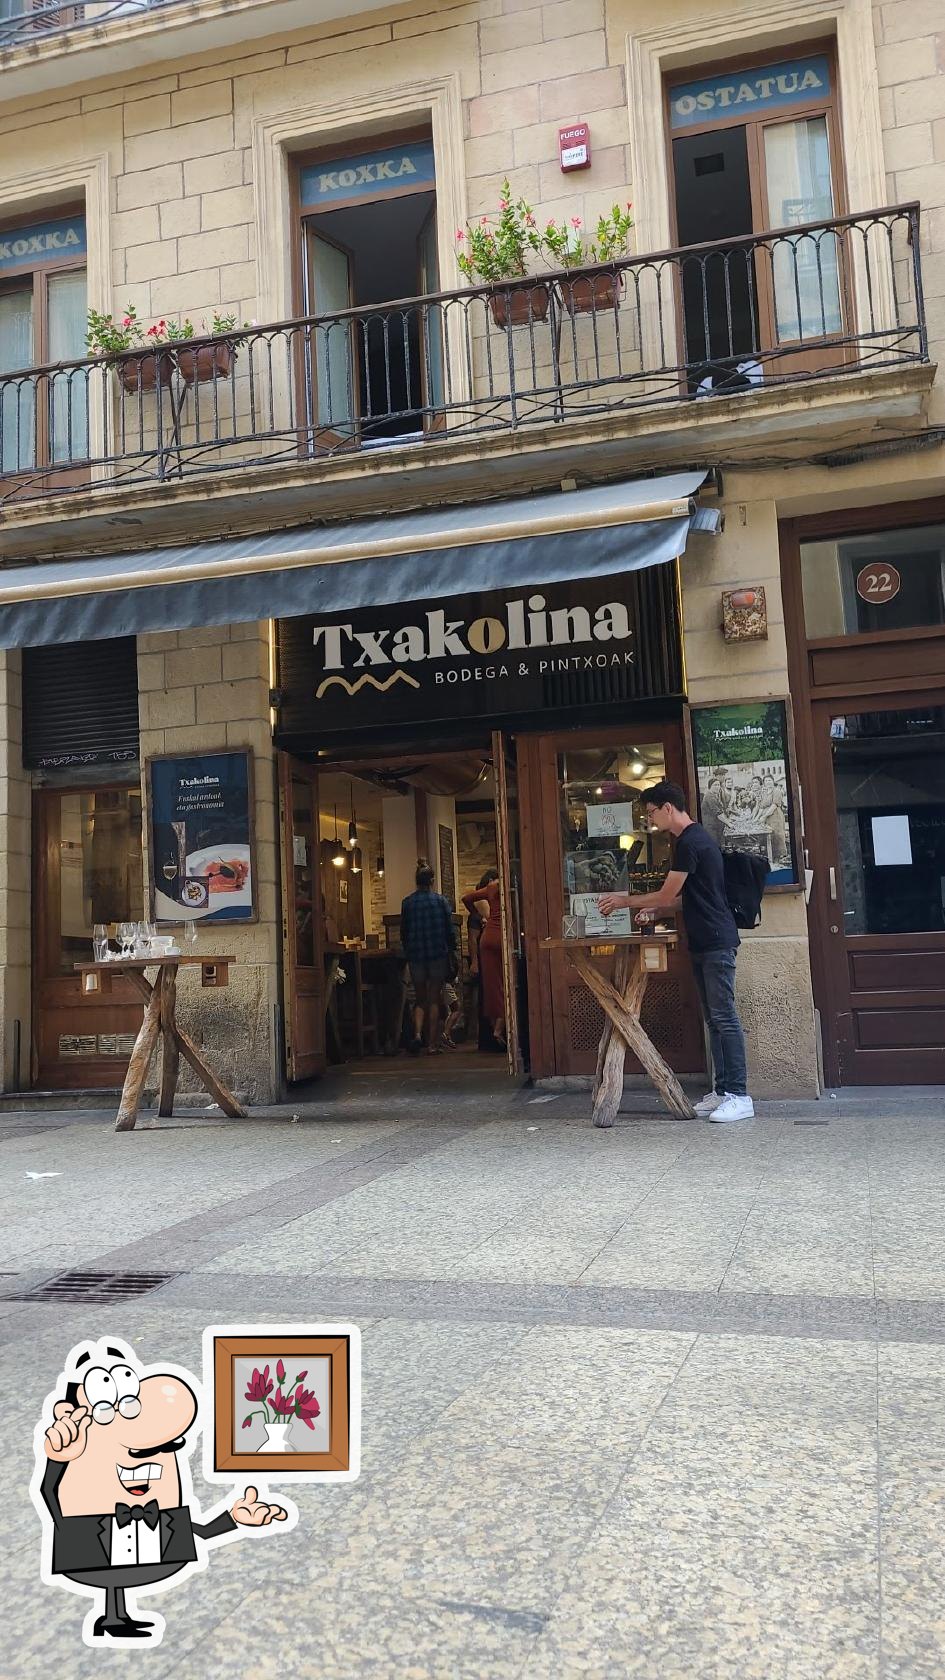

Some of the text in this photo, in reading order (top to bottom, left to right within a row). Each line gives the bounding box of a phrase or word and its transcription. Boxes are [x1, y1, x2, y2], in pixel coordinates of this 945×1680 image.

[675, 70, 823, 115] OSTATUA
[560, 128, 586, 140] FUEGO
[318, 157, 416, 192] KOXKA
[865, 573, 892, 593] 22
[313, 594, 632, 670] Txakolina
[435, 651, 635, 684] BODEGA & PINTXOAK
[713, 725, 763, 738] Txakolina
[179, 775, 219, 786] Txakolina
